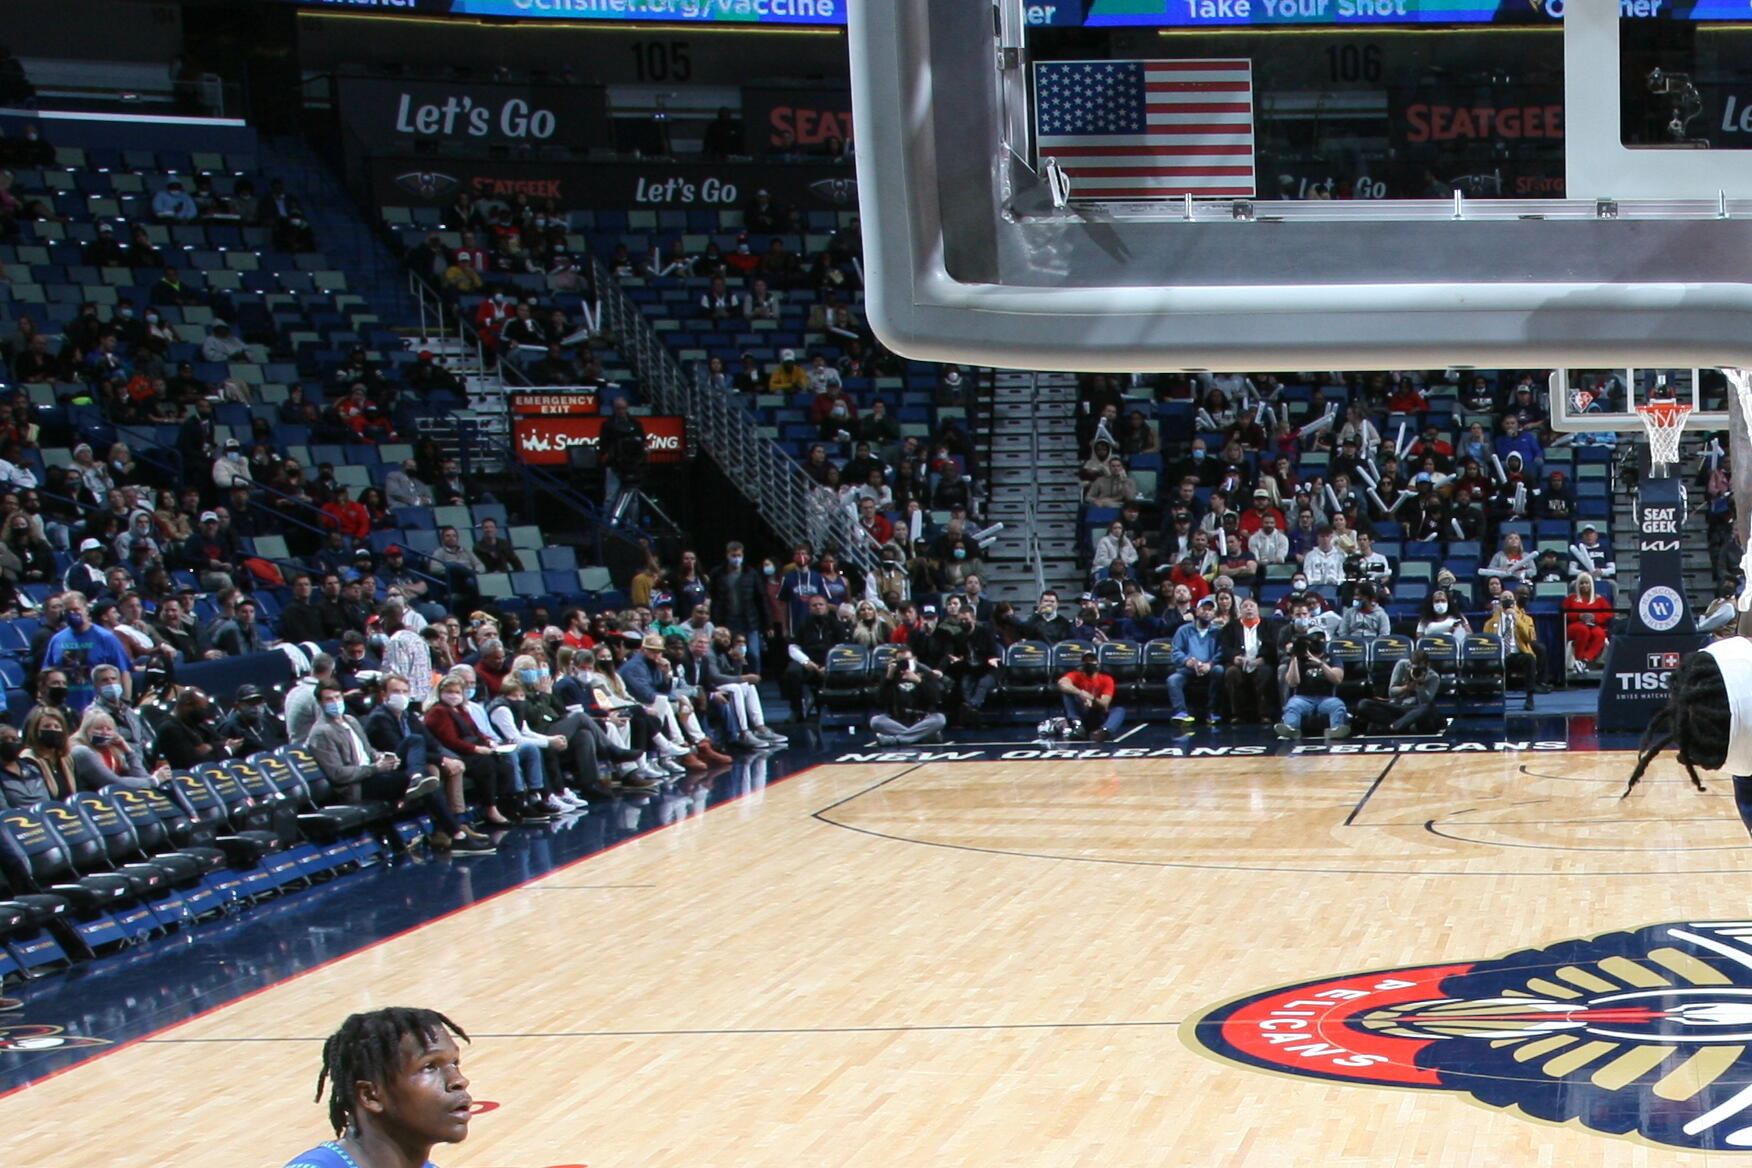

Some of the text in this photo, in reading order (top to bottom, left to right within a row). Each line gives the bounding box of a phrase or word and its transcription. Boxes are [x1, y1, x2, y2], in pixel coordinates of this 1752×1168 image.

[631, 41, 691, 81] 105
[1325, 44, 1382, 83] 106
[396, 93, 556, 138] Let's Go
[770, 105, 853, 147] SEAT
[1406, 103, 1564, 143] SEATGEE
[634, 176, 738, 203] Let's Go
[1356, 174, 1387, 199] Go
[515, 395, 595, 405] EMERGENCY
[541, 405, 570, 414] EXIT
[1642, 520, 1677, 534] GEEK
[1644, 508, 1676, 521] SEAT
[1615, 672, 1672, 690] TISS
[835, 740, 1568, 762] NEW ORLEANS PELICANS
[1257, 976, 1418, 1068] PELICANS
